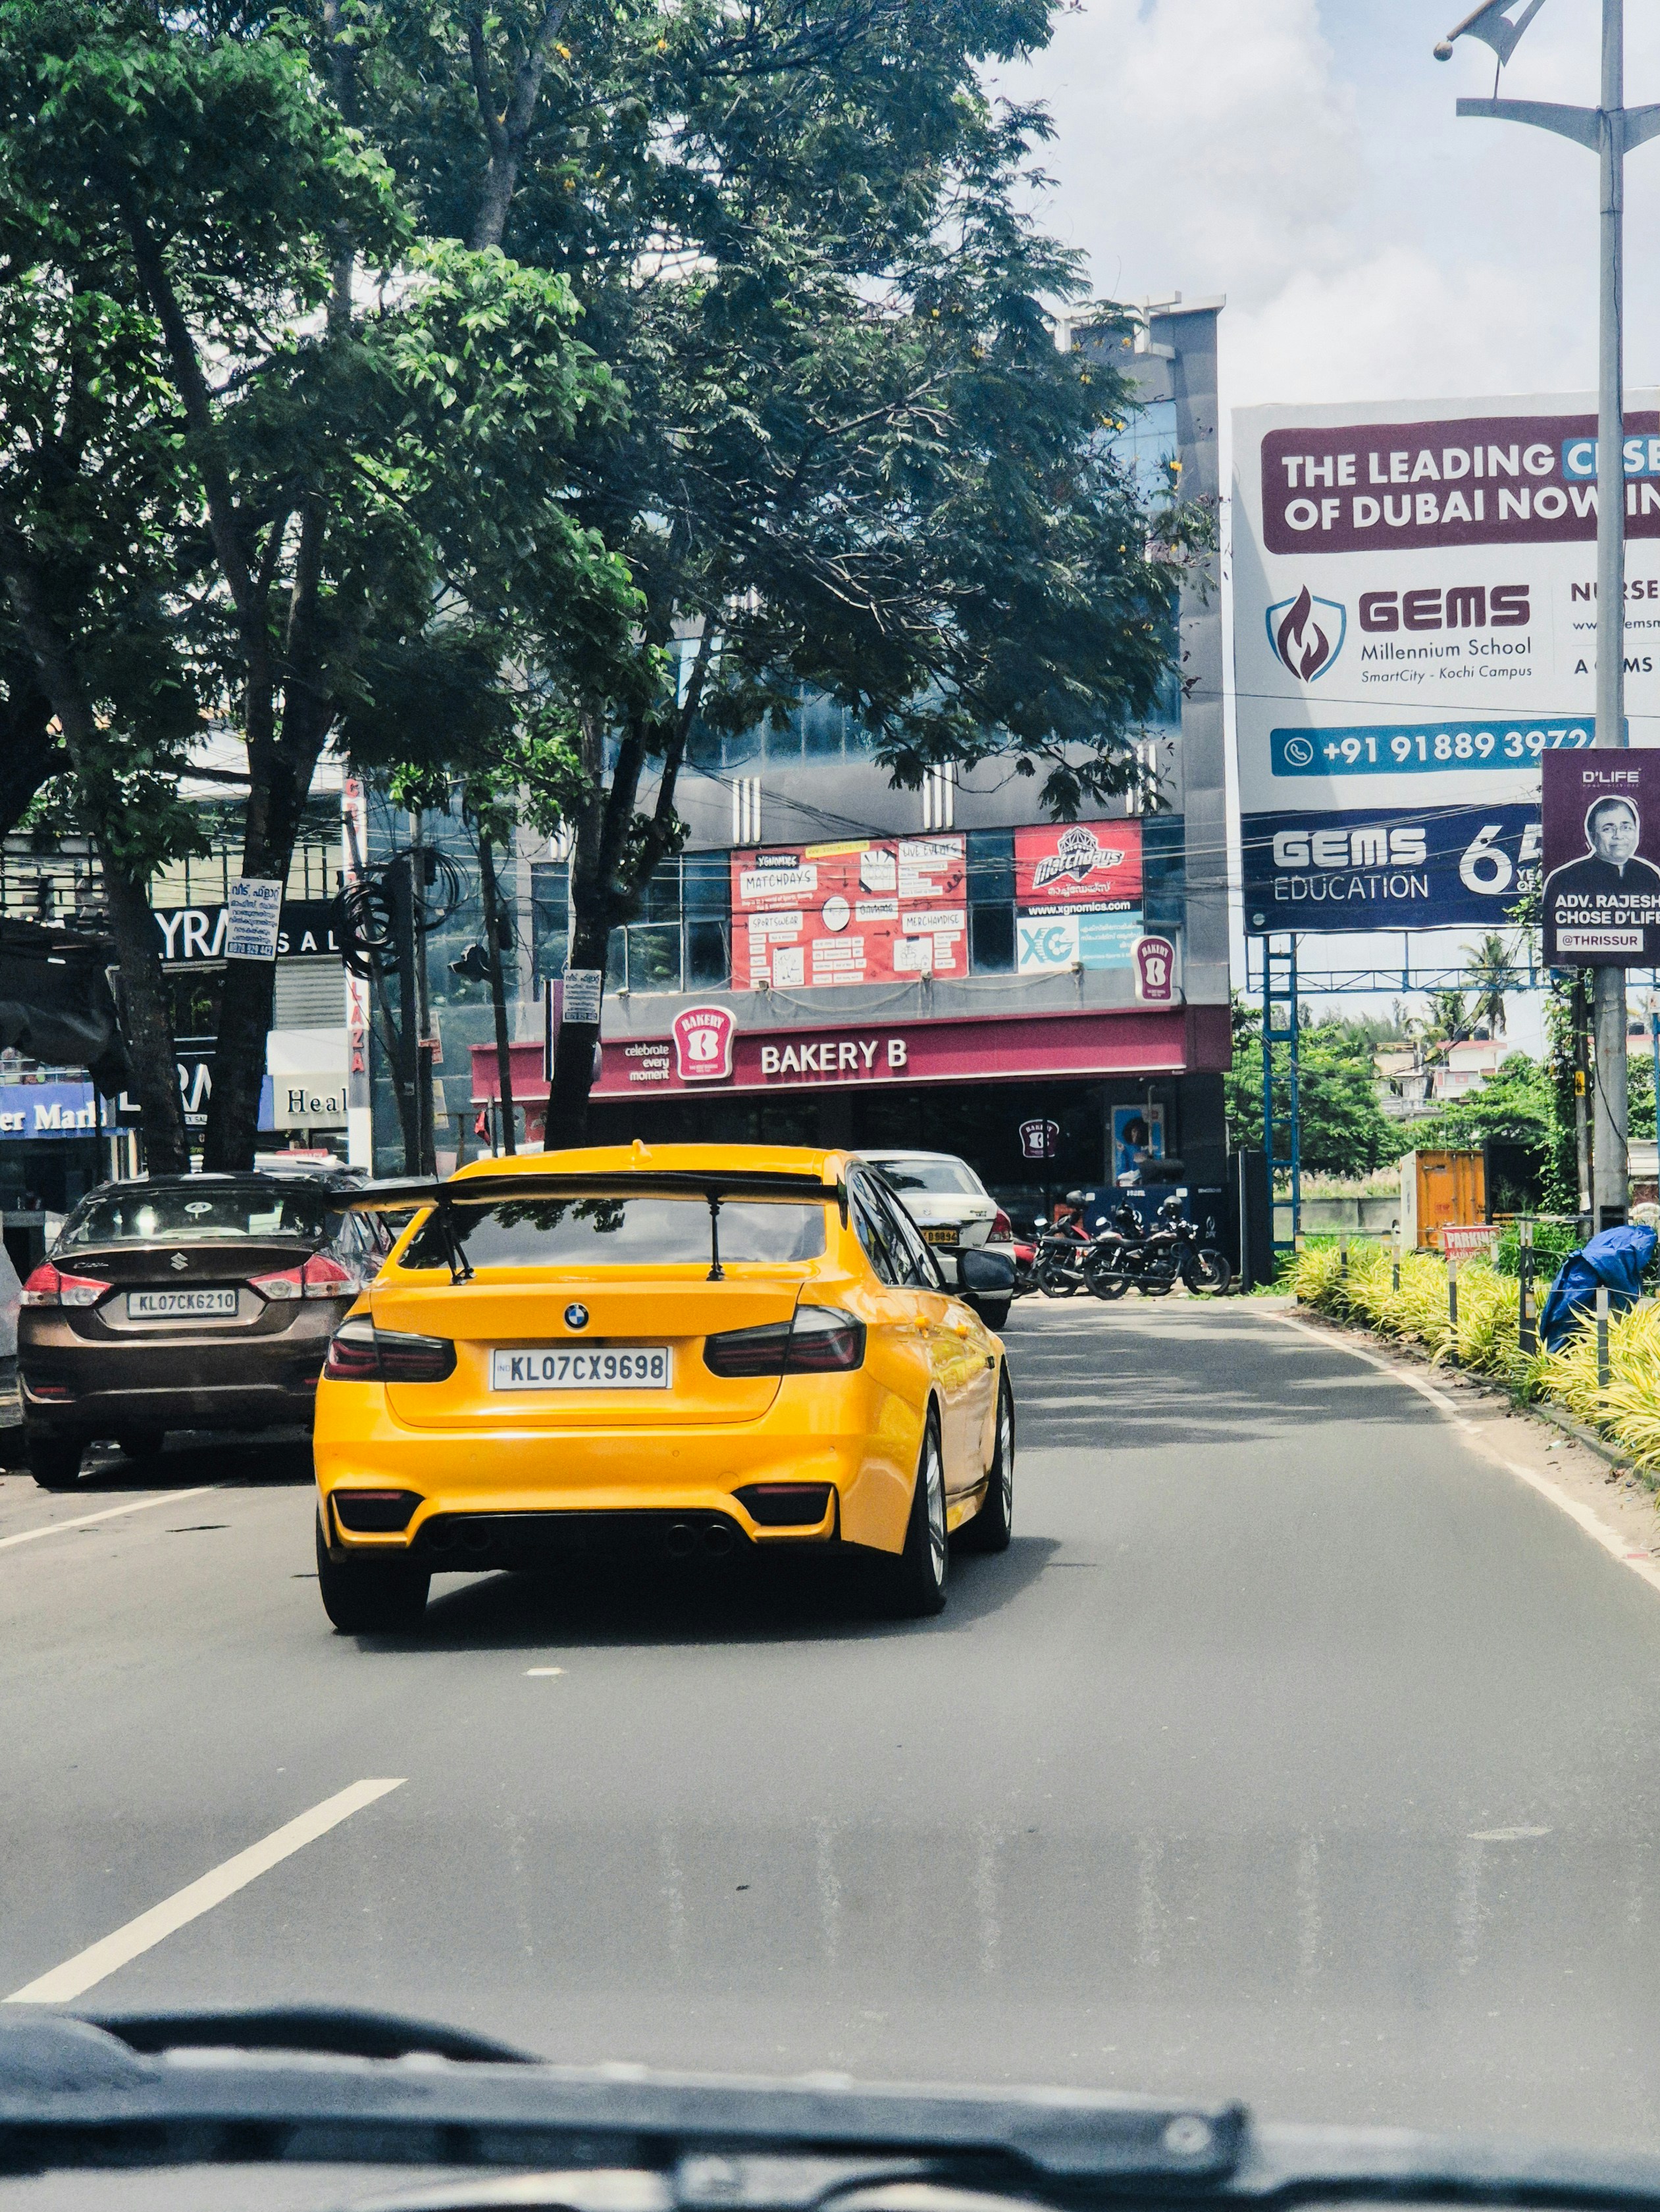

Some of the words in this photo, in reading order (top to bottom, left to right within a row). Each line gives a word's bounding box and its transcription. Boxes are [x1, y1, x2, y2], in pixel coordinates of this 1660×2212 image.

[1282, 454, 1356, 488] THE
[1369, 444, 1555, 484] LEADING
[1567, 439, 1660, 475] CSE
[1285, 498, 1340, 530] OF
[1353, 489, 1484, 528] DUBAI
[1359, 584, 1530, 632] GEMS
[1361, 642, 1461, 661] Millennium
[1468, 636, 1531, 656] School
[1362, 669, 1425, 684] SmartCity
[1439, 665, 1474, 680] Kochi
[1479, 665, 1532, 680] Campus
[1574, 659, 1588, 674] A
[1323, 737, 1376, 764] +91
[1390, 732, 1495, 762] 91889
[1504, 729, 1596, 758] 3972
[1582, 770, 1640, 783] D'LIFE
[1273, 828, 1427, 867] GEMS
[1035, 849, 1124, 887] Matchdays
[746, 870, 812, 890] MATCHDAYS
[1274, 875, 1428, 901] EDUCATION
[1029, 901, 1131, 916] www.xgnomics.com
[1555, 894, 1593, 908] ADV.
[752, 916, 798, 928] SPORTSWEAR
[906, 913, 959, 927] MERCHANDISE
[1555, 910, 1612, 924] CHOSE
[1562, 935, 1638, 946] @THRISSUR
[1141, 944, 1169, 958] BAKERY
[681, 1014, 725, 1032] BAKERY
[625, 1043, 669, 1057] celebrate
[761, 1041, 879, 1074] BAKERY
[888, 1039, 907, 1067] B
[642, 1057, 670, 1069] every
[629, 1069, 670, 1081] moment
[139, 1293, 234, 1311] KL07CK6210
[511, 1354, 663, 1381] KL07CX9698
